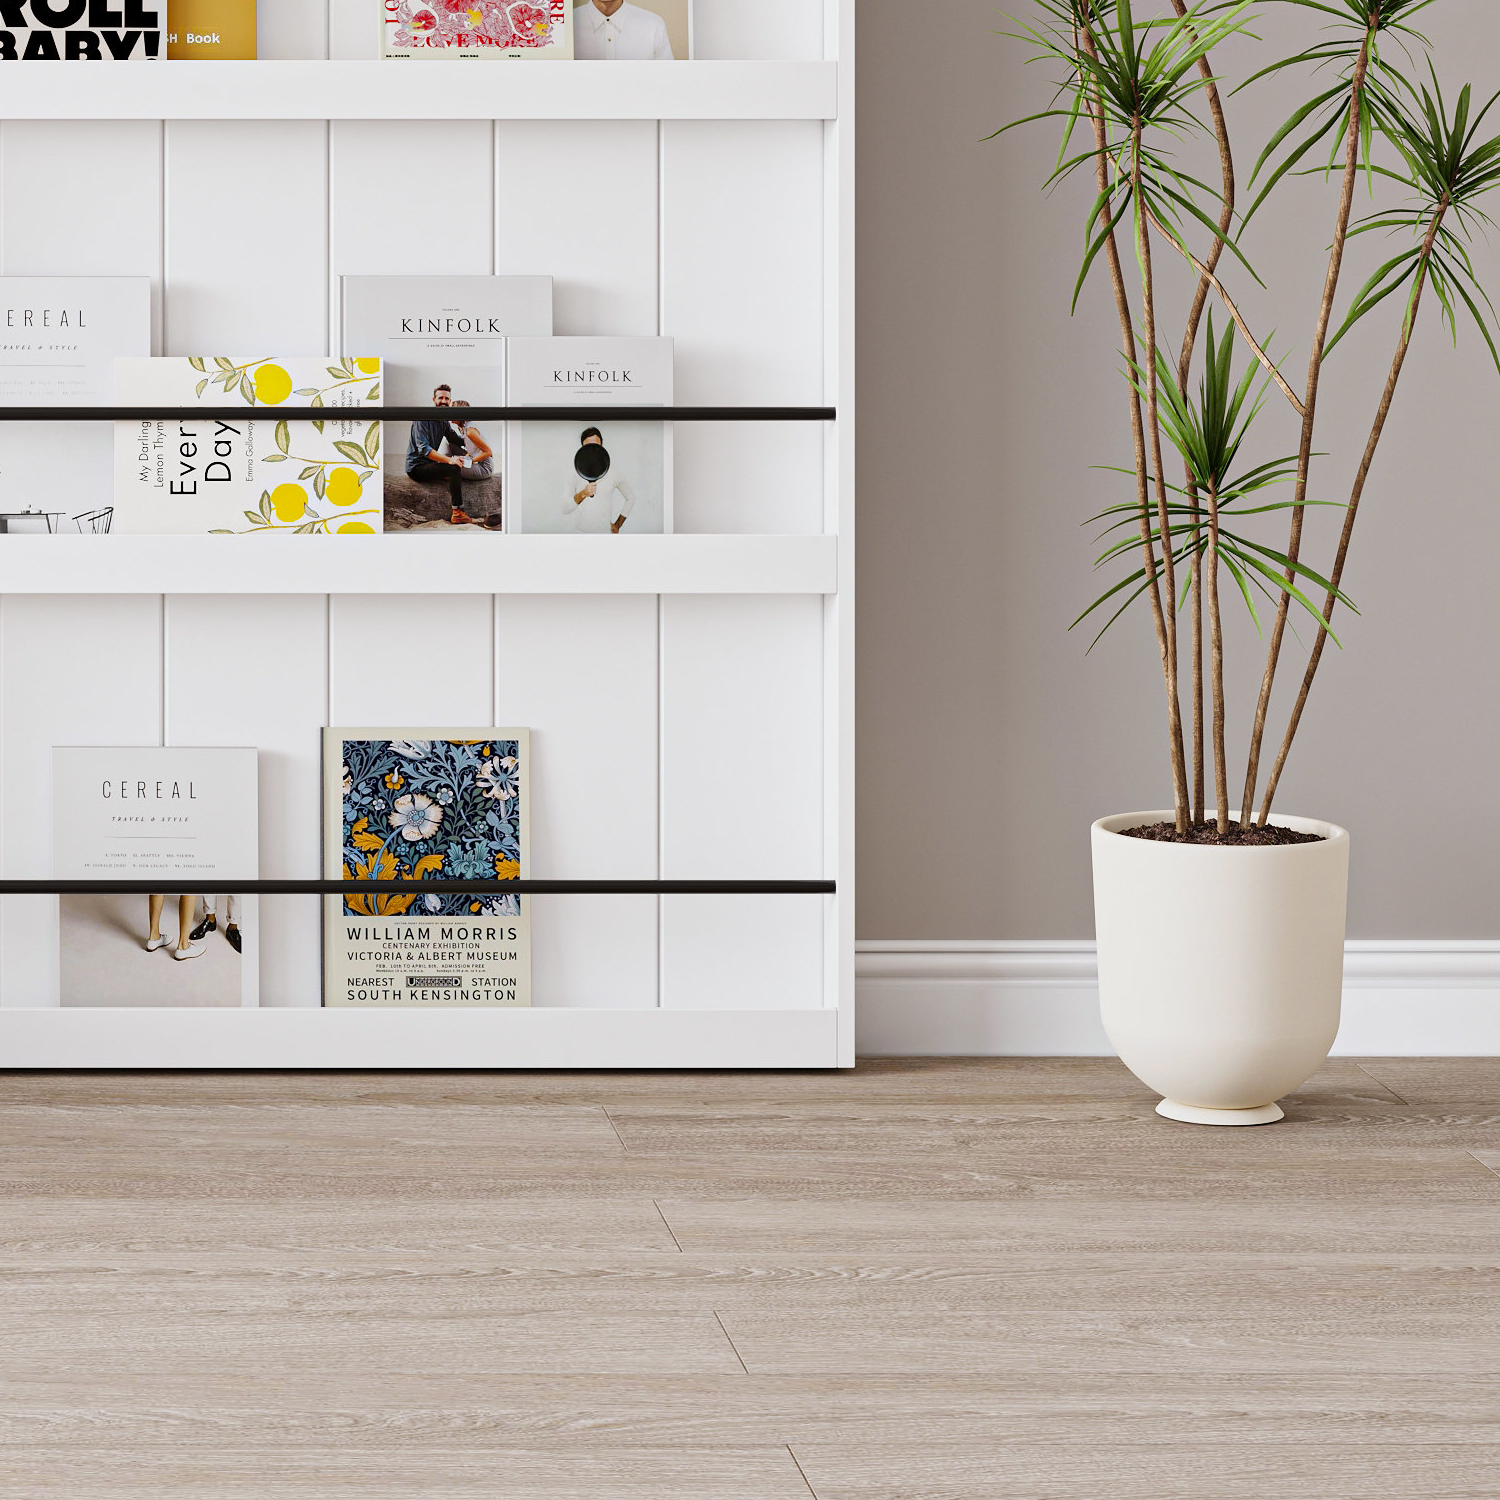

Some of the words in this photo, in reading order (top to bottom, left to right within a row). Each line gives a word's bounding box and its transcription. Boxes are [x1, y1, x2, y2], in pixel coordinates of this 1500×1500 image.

[186, 33, 220, 43] Book
[401, 318, 500, 332] KINFOLK
[553, 370, 632, 382] KINFOLK
[138, 420, 150, 461] Darling
[154, 420, 166, 450] Thym
[246, 420, 255, 456] Galloway
[205, 420, 241, 482] Day
[139, 465, 151, 482] My
[154, 454, 164, 488] Lemon
[246, 458, 254, 482] Emma
[102, 780, 197, 799] CEREAL
[347, 928, 430, 940] WILLIAM
[441, 928, 517, 940] MORRIS
[347, 952, 402, 960] VICTORIA
[406, 952, 414, 960] &
[418, 952, 462, 960] ALBERT
[467, 952, 517, 960] MUSEUM
[348, 978, 394, 986] NEAREST
[472, 978, 516, 986] STATION
[348, 990, 401, 1000] SOUTH
[411, 990, 516, 1000] KENSINGTON
